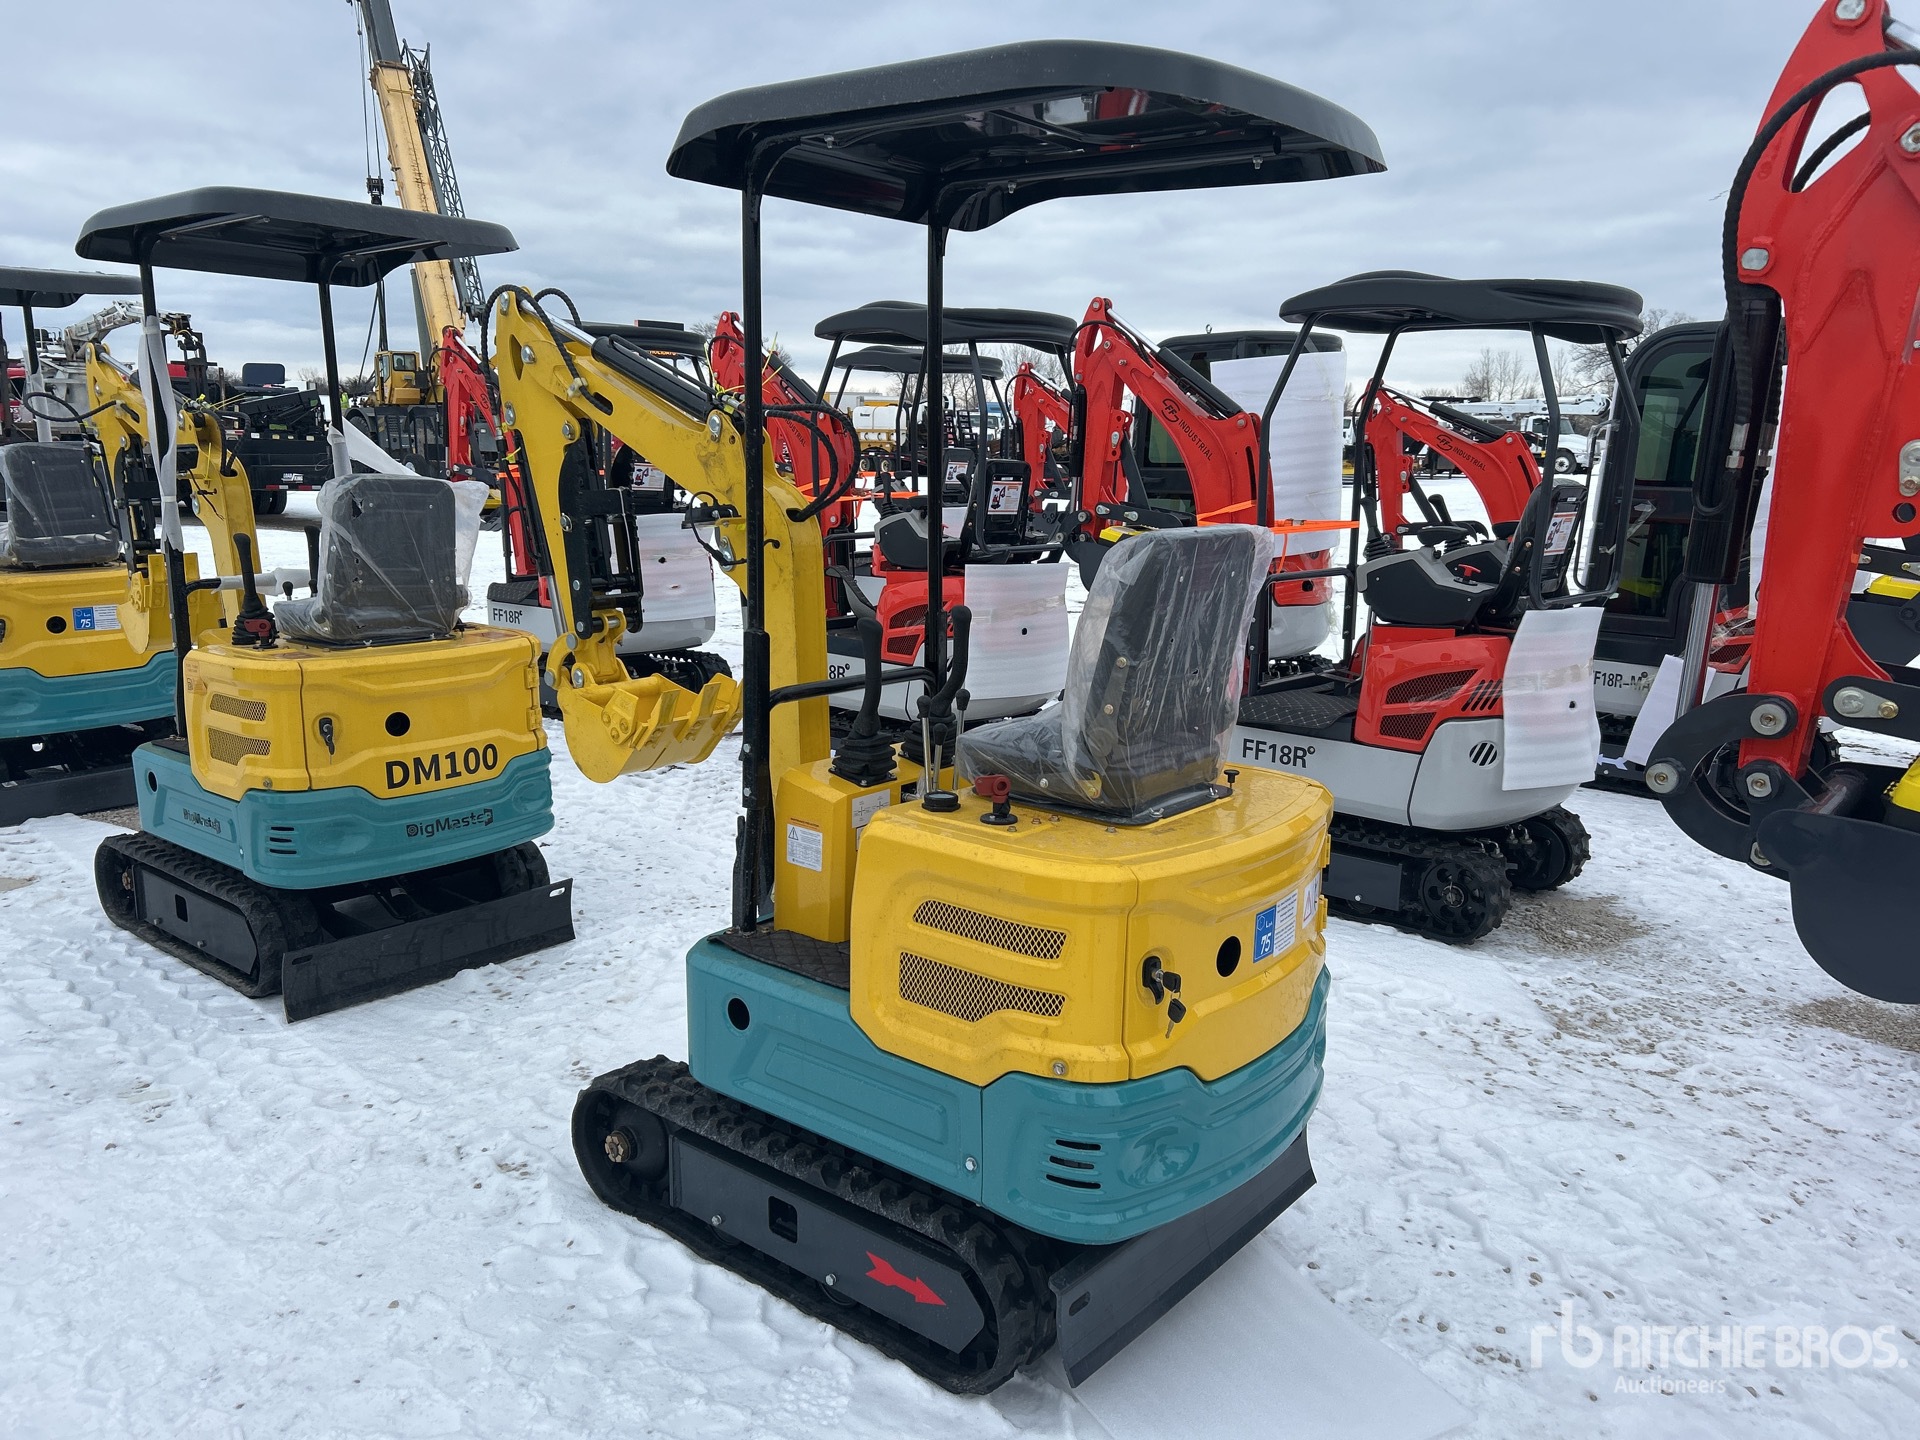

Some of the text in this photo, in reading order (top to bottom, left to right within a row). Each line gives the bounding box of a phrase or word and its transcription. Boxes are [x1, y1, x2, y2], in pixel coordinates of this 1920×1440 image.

[1179, 420, 1213, 461] INDUSTRIAL
[1453, 447, 1487, 471] INDUSTRIAL
[80, 618, 91, 628] 75
[493, 608, 521, 625] FF18R
[1242, 738, 1308, 768] FF18R
[385, 743, 499, 790] DM100
[1260, 932, 1272, 955] 75
